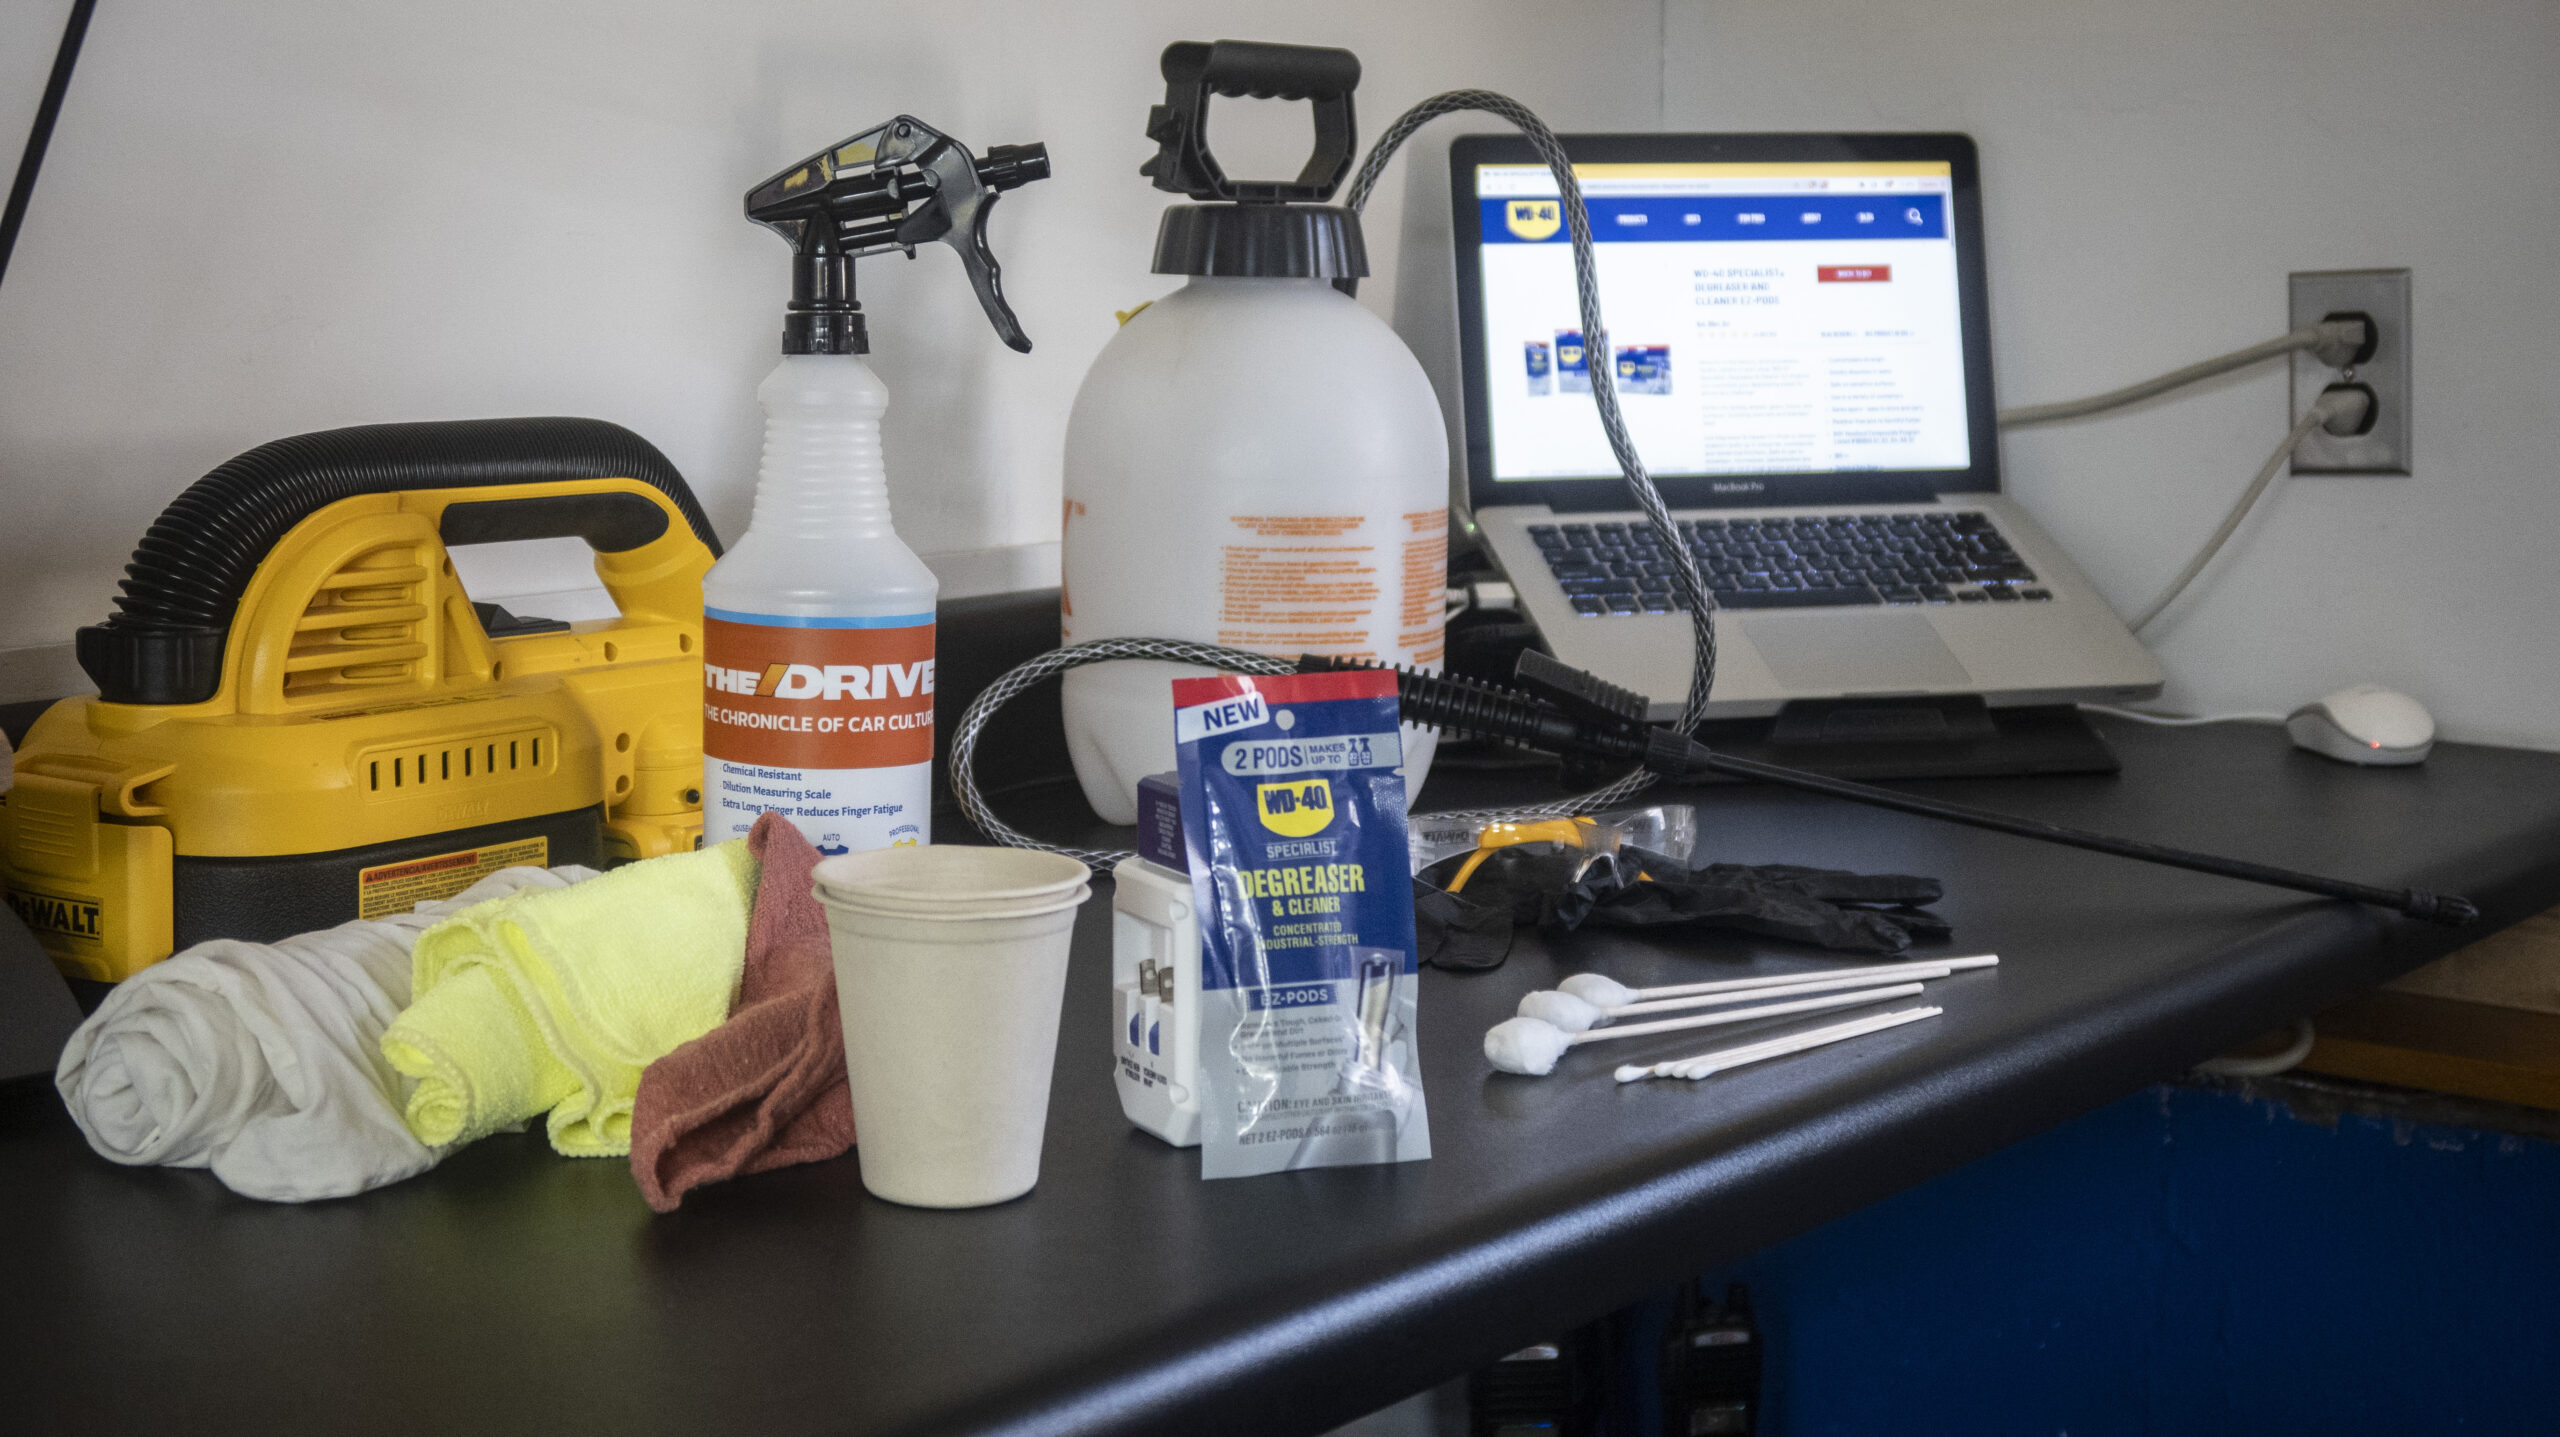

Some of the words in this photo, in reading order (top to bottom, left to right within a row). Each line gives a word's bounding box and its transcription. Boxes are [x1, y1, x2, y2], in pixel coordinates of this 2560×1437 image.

[1713, 482, 1749, 492] MacBook
[1751, 482, 1765, 492] Pro
[704, 663, 761, 695] THE
[774, 658, 935, 700] DRIVE
[704, 704, 719, 722] THE
[721, 708, 813, 732] CHRONICLE
[817, 717, 845, 732] OF
[848, 716, 885, 732] CAR
[1203, 698, 1260, 731] NEW
[1235, 749, 1247, 769] 2
[1254, 746, 1303, 769] PODS
[1309, 743, 1346, 754] MAKES
[1311, 755, 1326, 765] UP
[1328, 755, 1341, 764] TO
[723, 763, 756, 777] Chemical
[758, 768, 802, 781] Resistant
[723, 780, 751, 794] Dilution
[753, 785, 802, 801] Measuring
[804, 789, 832, 800] Scale
[722, 798, 740, 810] Extra
[742, 801, 762, 816] Long
[796, 806, 839, 817] Reduces
[842, 806, 871, 818] Finger
[873, 803, 903, 816] Fatigue
[1264, 785, 1328, 815] WD-40
[733, 824, 752, 834] HOUSE
[889, 824, 920, 838] PROFESSIONAL
[823, 834, 841, 843] AUTO
[1266, 840, 1337, 859] SPECIALIST
[1238, 864, 1365, 898] DEGREASER
[1272, 900, 1284, 916] &
[1288, 896, 1340, 915] CLEANER
[1262, 934, 1358, 950] DUSTRIAL-STRENGTH
[1261, 989, 1328, 1006] EZ-PODS
[1239, 1132, 1256, 1145] NET
